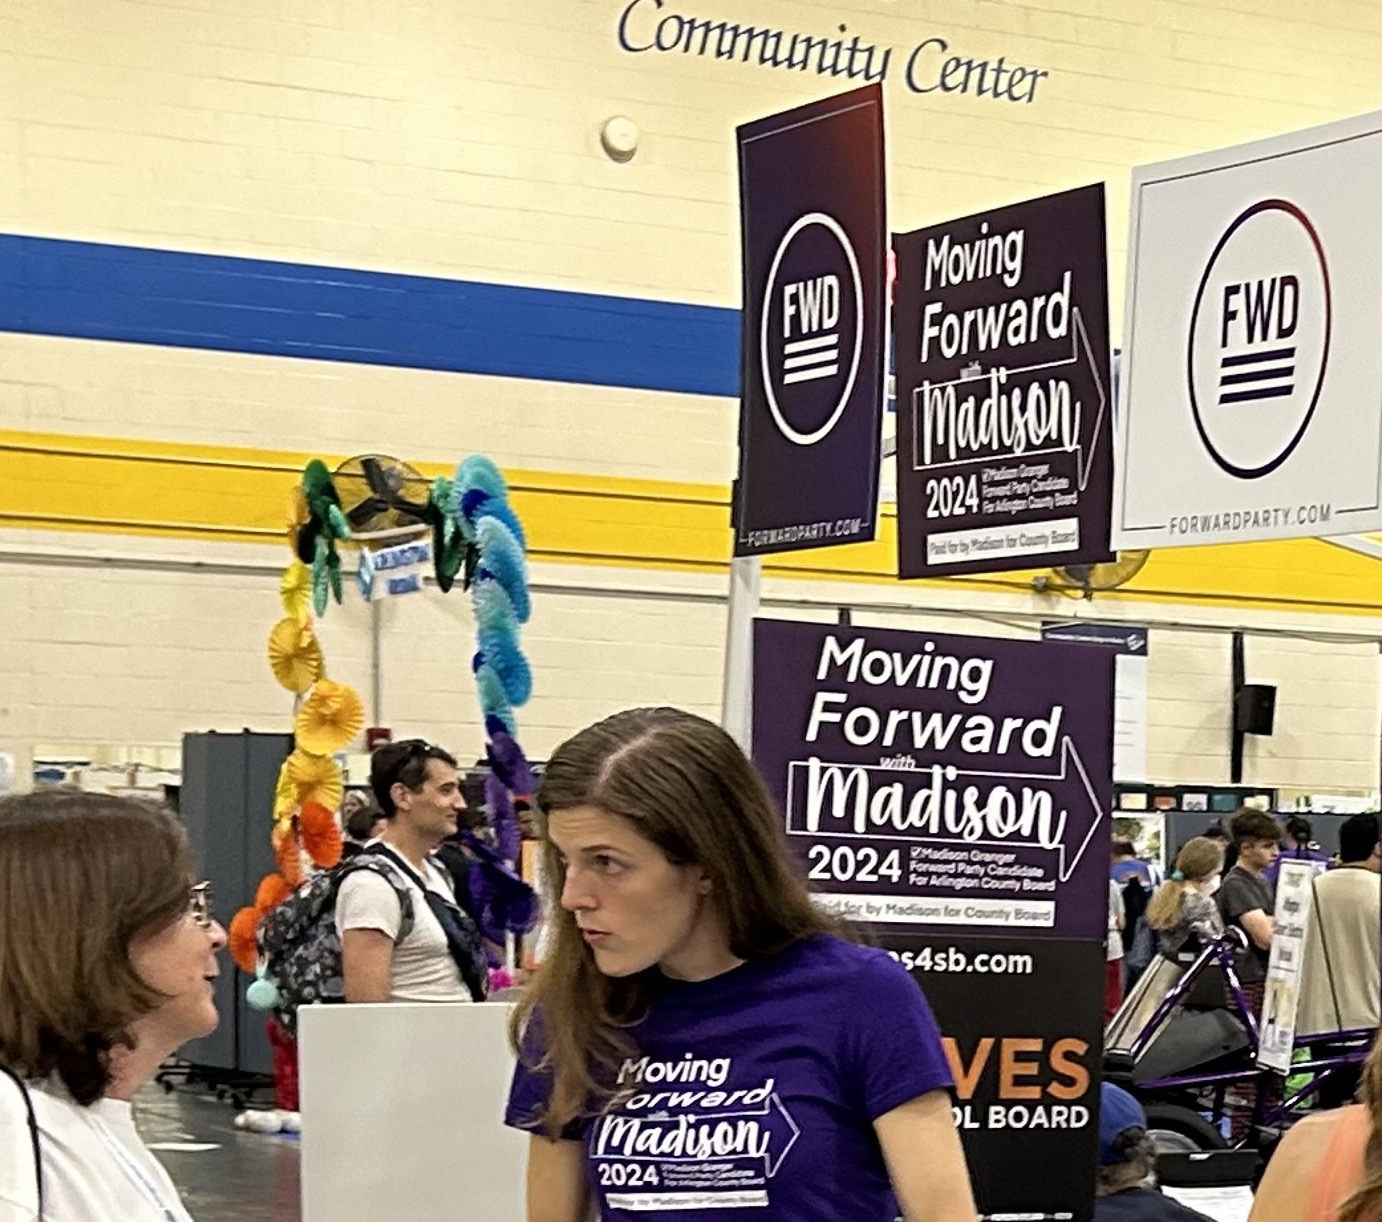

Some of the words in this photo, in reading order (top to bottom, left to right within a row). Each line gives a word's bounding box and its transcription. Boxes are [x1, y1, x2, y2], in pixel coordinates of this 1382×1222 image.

[617, 0, 892, 82] Community
[905, 38, 1049, 103] Center
[924, 222, 1025, 291] Moving
[783, 274, 840, 338] FWD
[920, 270, 1072, 363] Forward
[1221, 274, 1299, 349] FWD
[923, 366, 1081, 465] Madison
[926, 474, 979, 518] 2024
[1169, 503, 1332, 536] FORWARDPARTY.COM
[816, 635, 994, 704] Moving
[805, 691, 1064, 758] Forward
[879, 753, 917, 769] with
[806, 756, 1067, 850] Madison
[808, 845, 902, 883] 2024
[887, 947, 1034, 974] s4sb.com
[616, 1053, 731, 1086] Moving
[620, 1078, 775, 1110] orward
[941, 1037, 1092, 1100] VES
[597, 1113, 770, 1160] Madison
[988, 1105, 1090, 1129] BOARD
[599, 1163, 660, 1186] 2024
